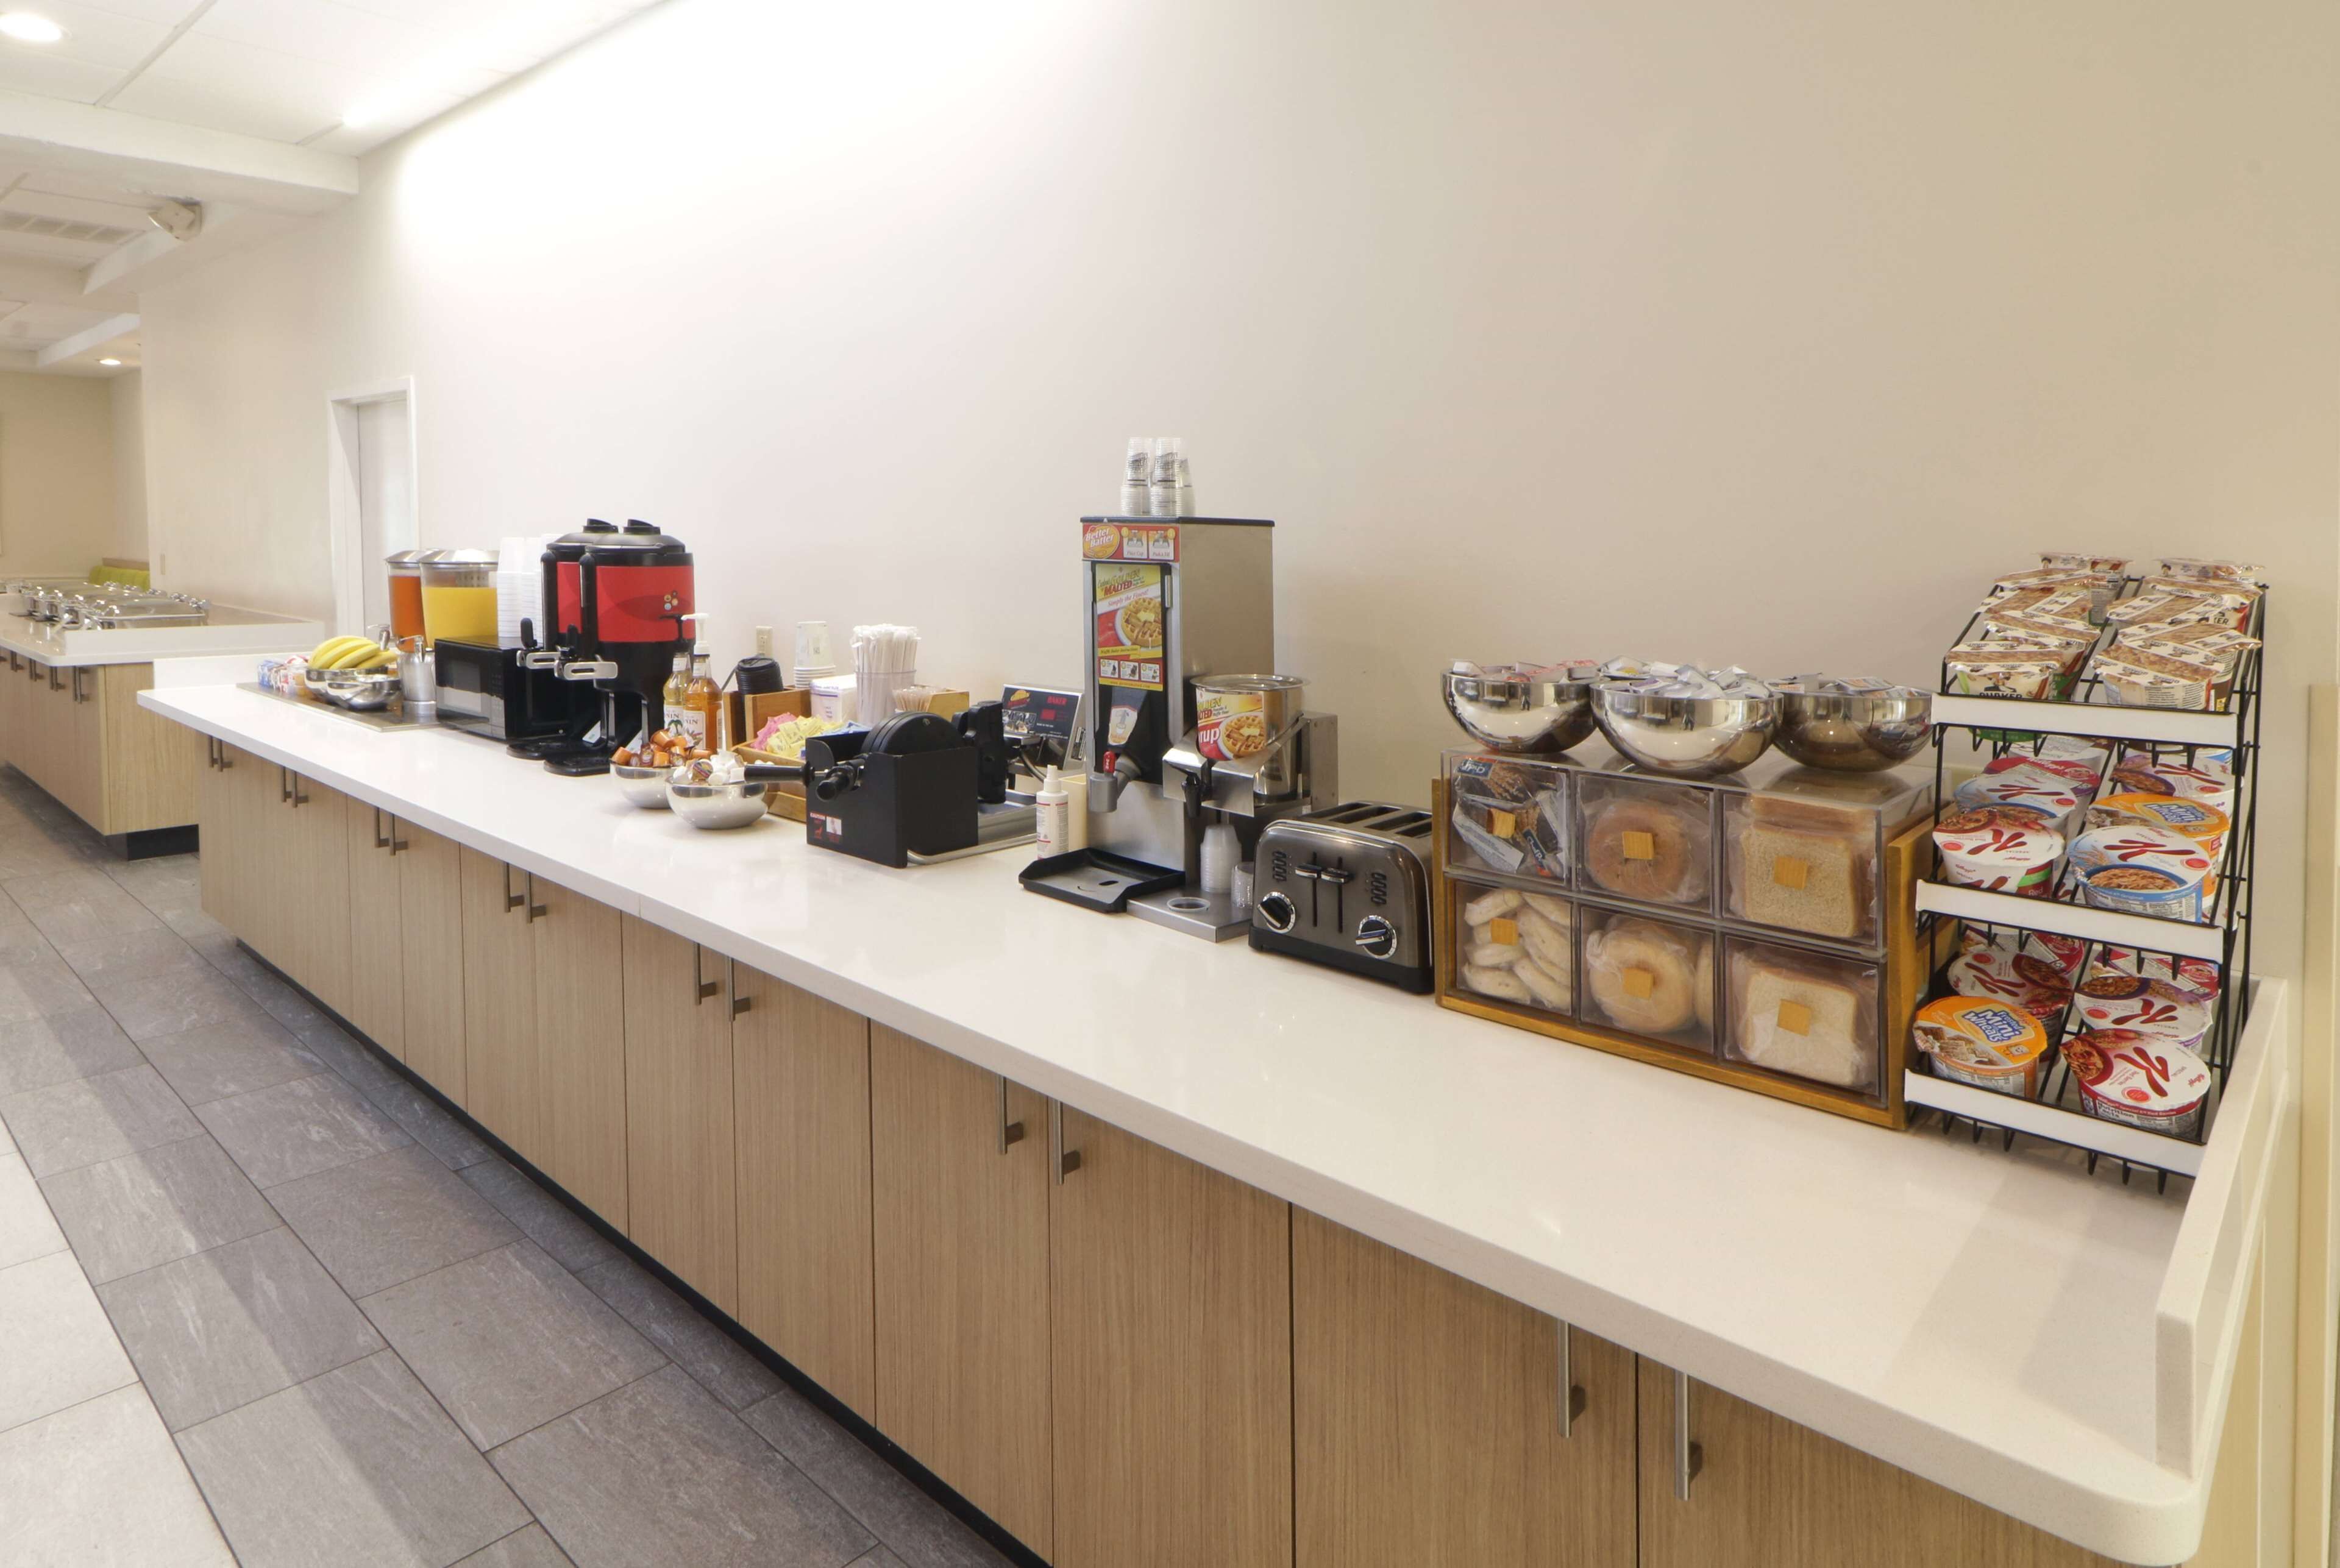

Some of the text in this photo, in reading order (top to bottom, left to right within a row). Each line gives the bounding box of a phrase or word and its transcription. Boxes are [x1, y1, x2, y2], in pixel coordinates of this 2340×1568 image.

[1086, 528, 1110, 541] Better
[1091, 534, 1115, 547] Batter
[1104, 580, 1133, 597] MALTED
[1047, 695, 1068, 706] BAKER
[1198, 708, 1213, 720] LTED
[1199, 728, 1220, 744] rup
[2028, 887, 2043, 897] Red
[1962, 1010, 2005, 1043] Wheats
[1978, 1009, 2022, 1038] Mini
[1996, 1010, 2025, 1031] Frosted
[2097, 1100, 2135, 1119] Nutrition
[2098, 1106, 2120, 1118] Facts
